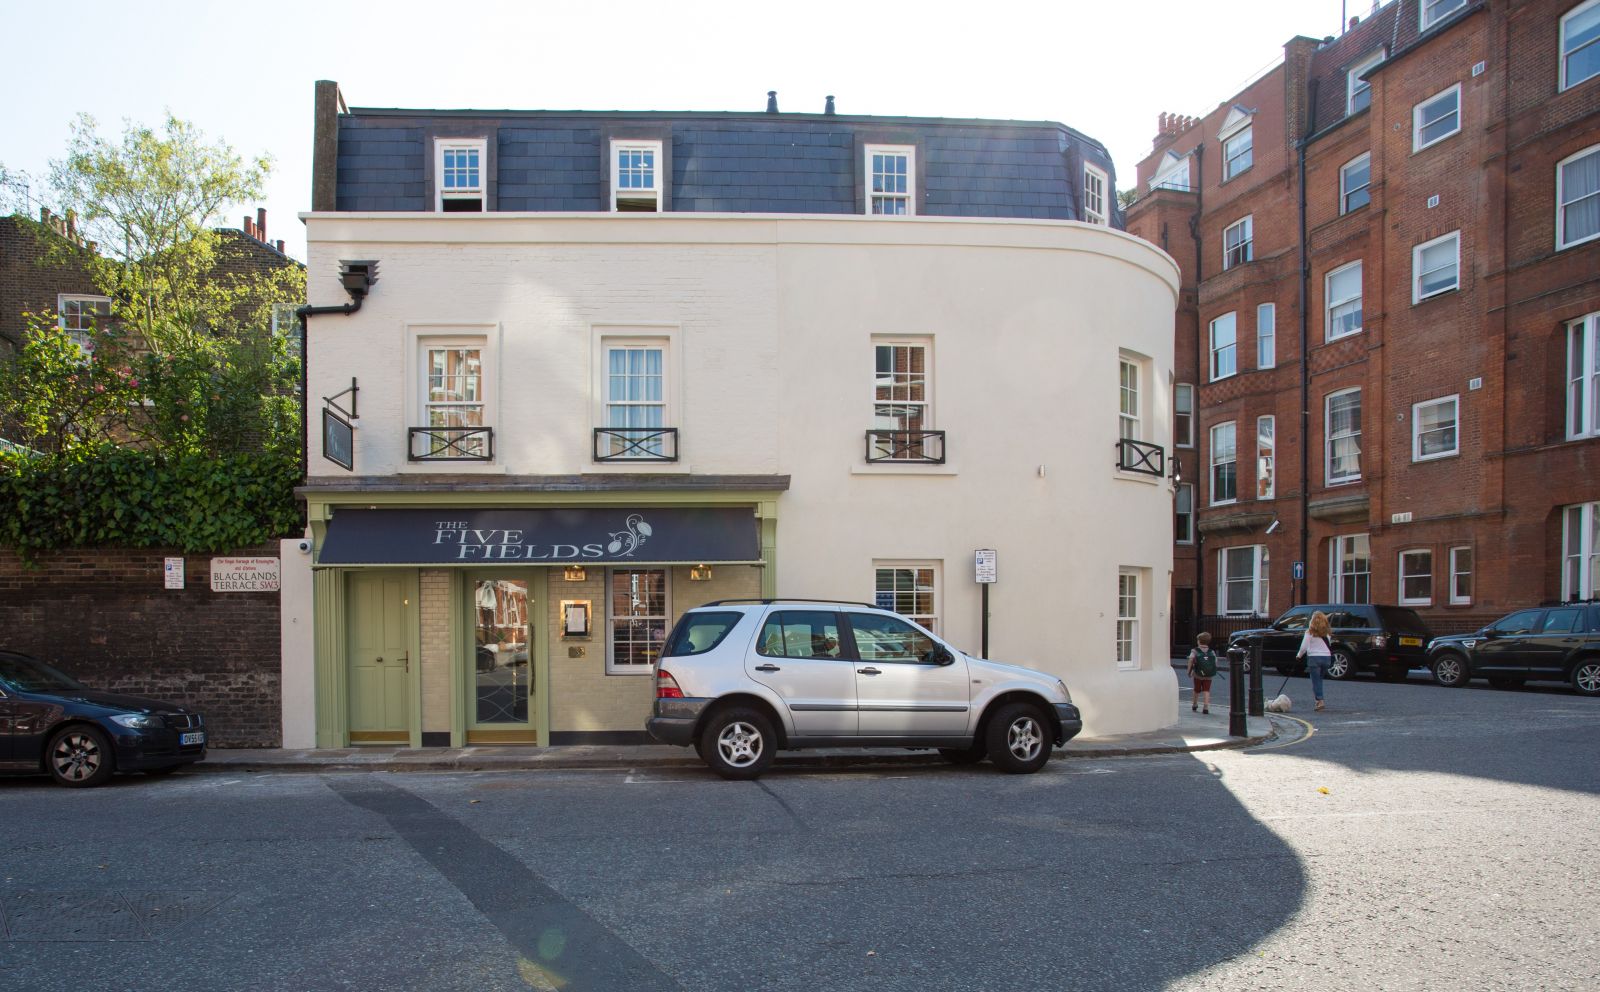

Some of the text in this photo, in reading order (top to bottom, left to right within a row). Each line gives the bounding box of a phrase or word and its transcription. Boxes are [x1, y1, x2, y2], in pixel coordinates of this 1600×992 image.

[435, 521, 469, 529] THE
[432, 529, 524, 545] FIVE
[456, 543, 604, 559] FIELDS
[213, 572, 277, 581] BLACKLANDS
